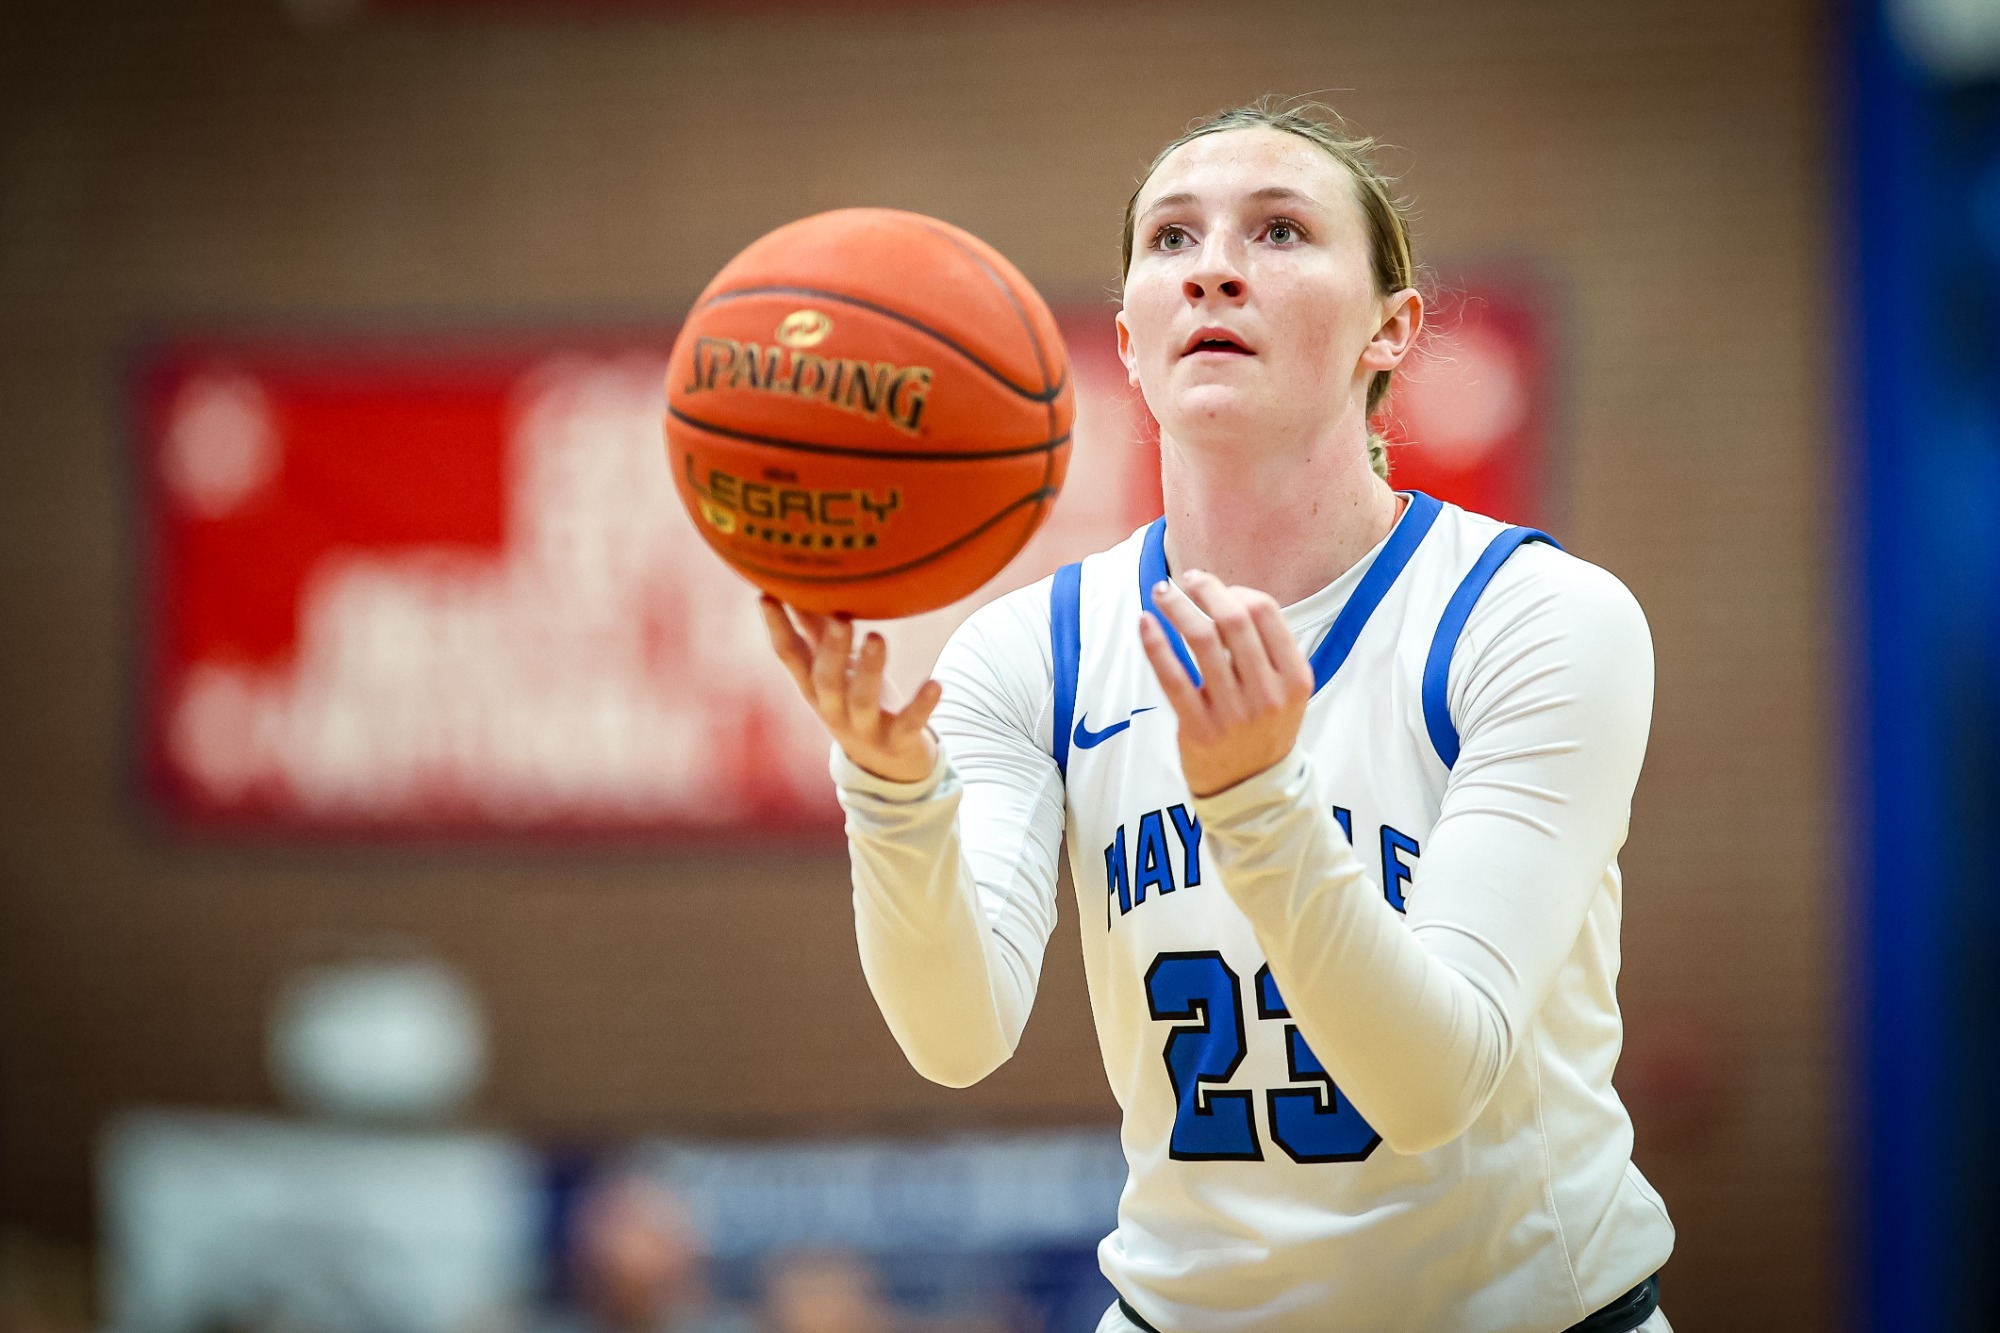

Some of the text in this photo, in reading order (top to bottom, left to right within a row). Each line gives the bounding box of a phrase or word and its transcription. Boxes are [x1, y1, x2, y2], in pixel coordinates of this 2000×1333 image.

[684, 337, 934, 437] SPALDING
[685, 453, 899, 526] LEGACY
[1144, 950, 1383, 1164] 23
